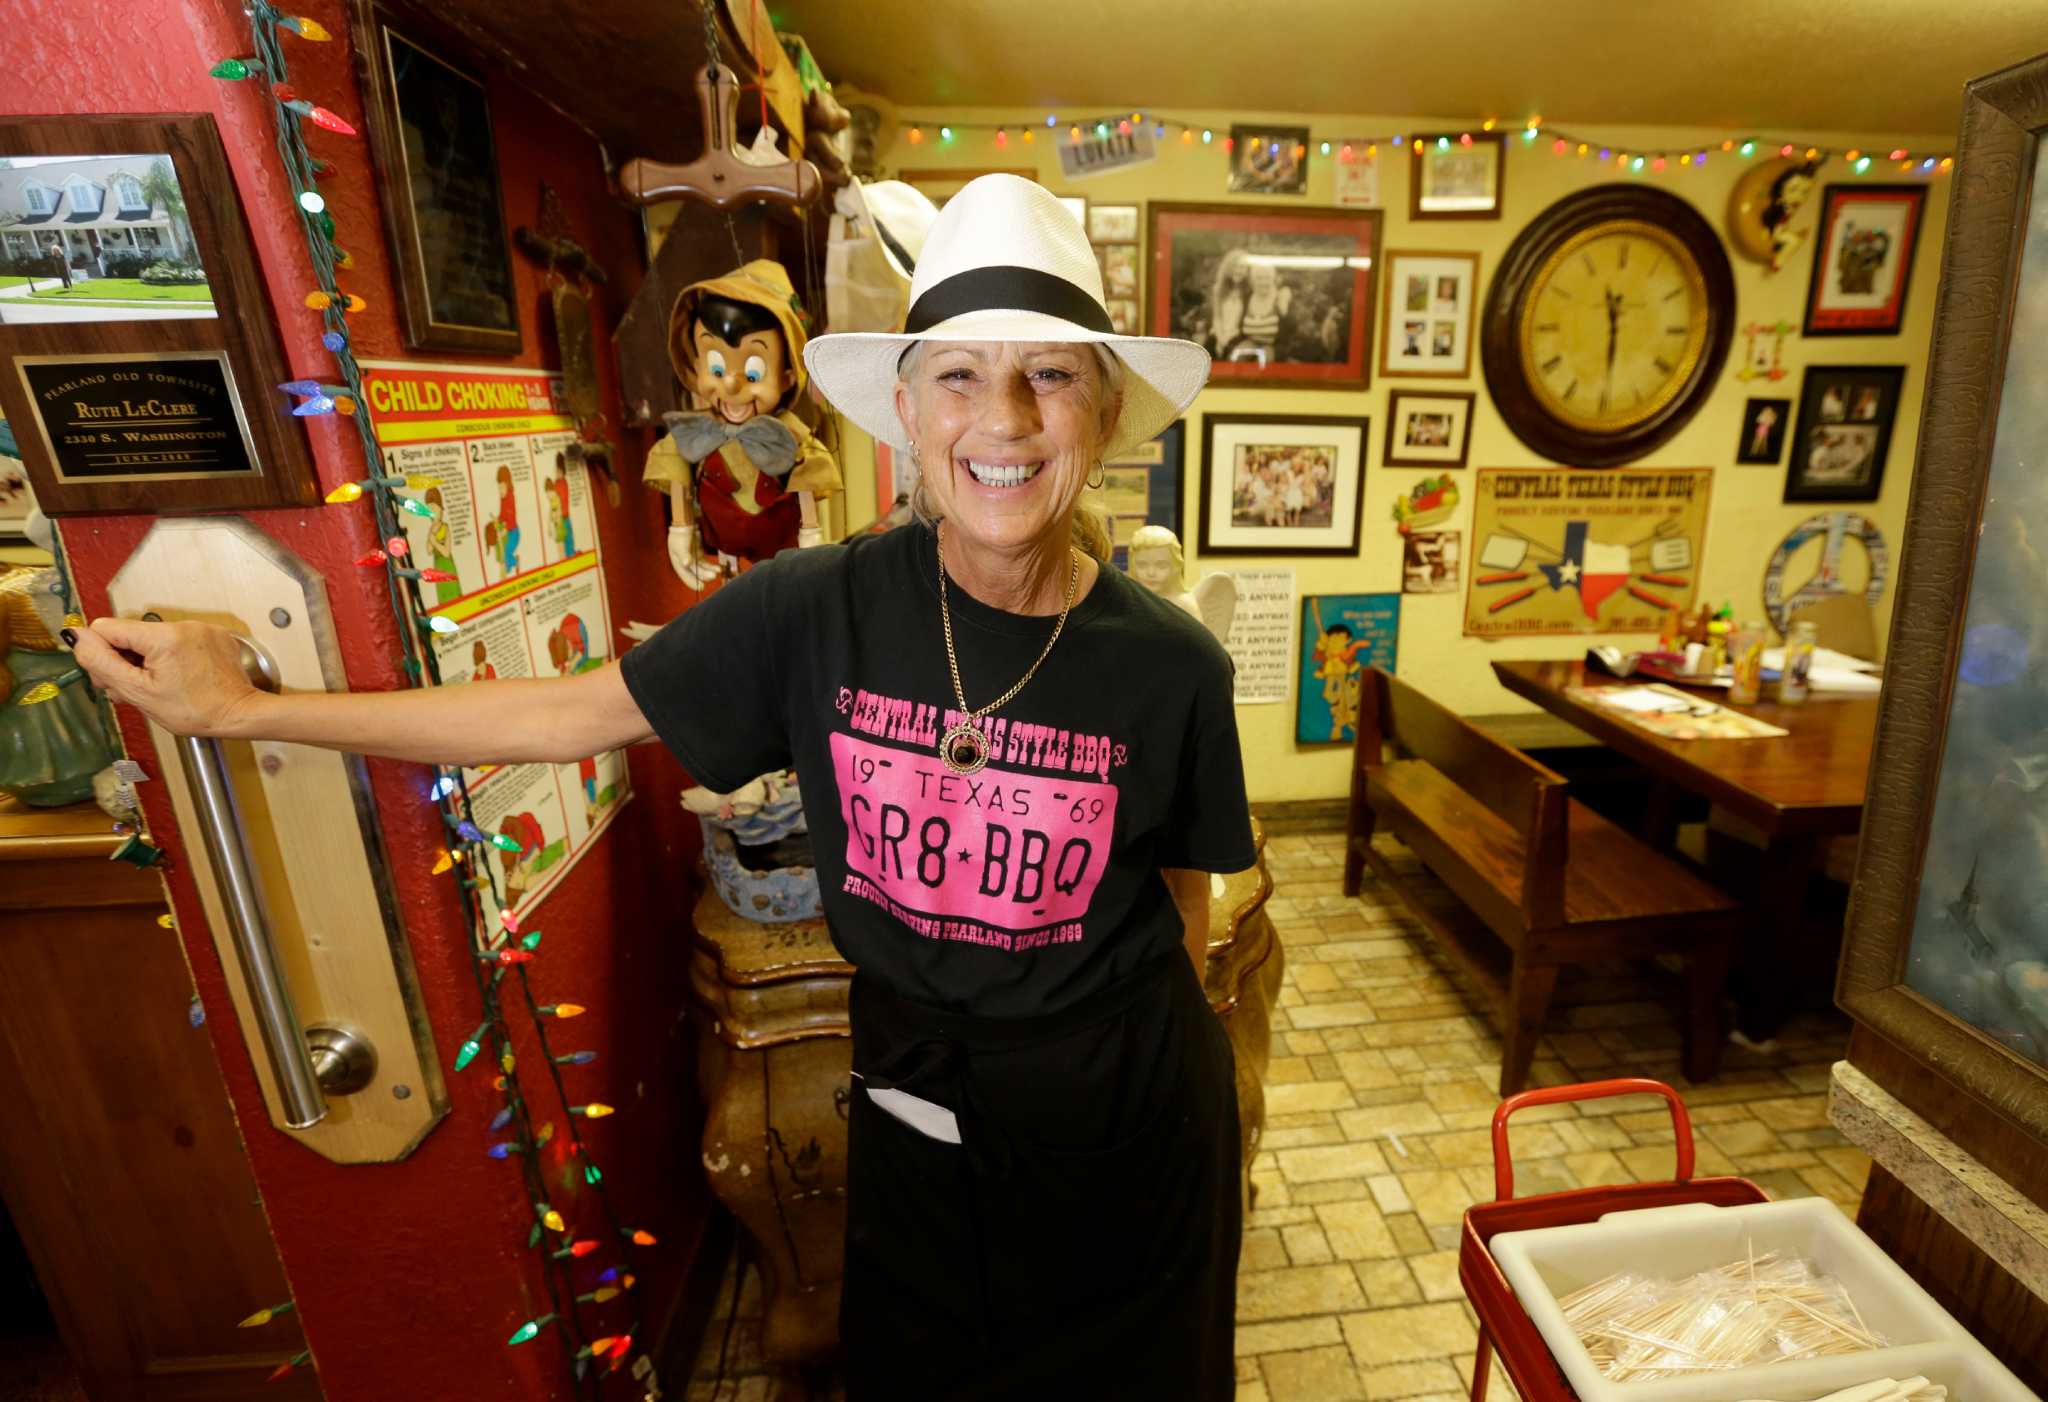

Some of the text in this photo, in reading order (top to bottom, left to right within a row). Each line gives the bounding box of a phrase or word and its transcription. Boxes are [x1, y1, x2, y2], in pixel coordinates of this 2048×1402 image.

[44, 372, 217, 400] PEARLAND OLD TOWNSITE
[370, 379, 444, 412] CHILD
[447, 381, 529, 411] CHOKING
[100, 433, 117, 443] S.
[401, 448, 422, 461] Signs
[424, 447, 432, 456] of
[433, 446, 461, 457] choking
[1495, 475, 1694, 503] CENTRAL TEXAS STYLE BBQ
[1250, 592, 1290, 601] ANYWAY
[1252, 612, 1290, 621] ANYWAY
[1247, 636, 1288, 645] ANYWAY
[1251, 649, 1288, 658] ANYWAY
[1249, 663, 1286, 671] ANYWAY
[850, 689, 938, 748] CENTRAL
[1006, 720, 1070, 770] STYLE
[1070, 733, 1111, 784] BBQ
[915, 770, 1031, 816] TEXAS
[1070, 797, 1104, 824] 69
[851, 794, 1093, 904] GR8 BBQ
[943, 921, 1012, 952] PEARLAND
[1014, 930, 1050, 952] SINCE
